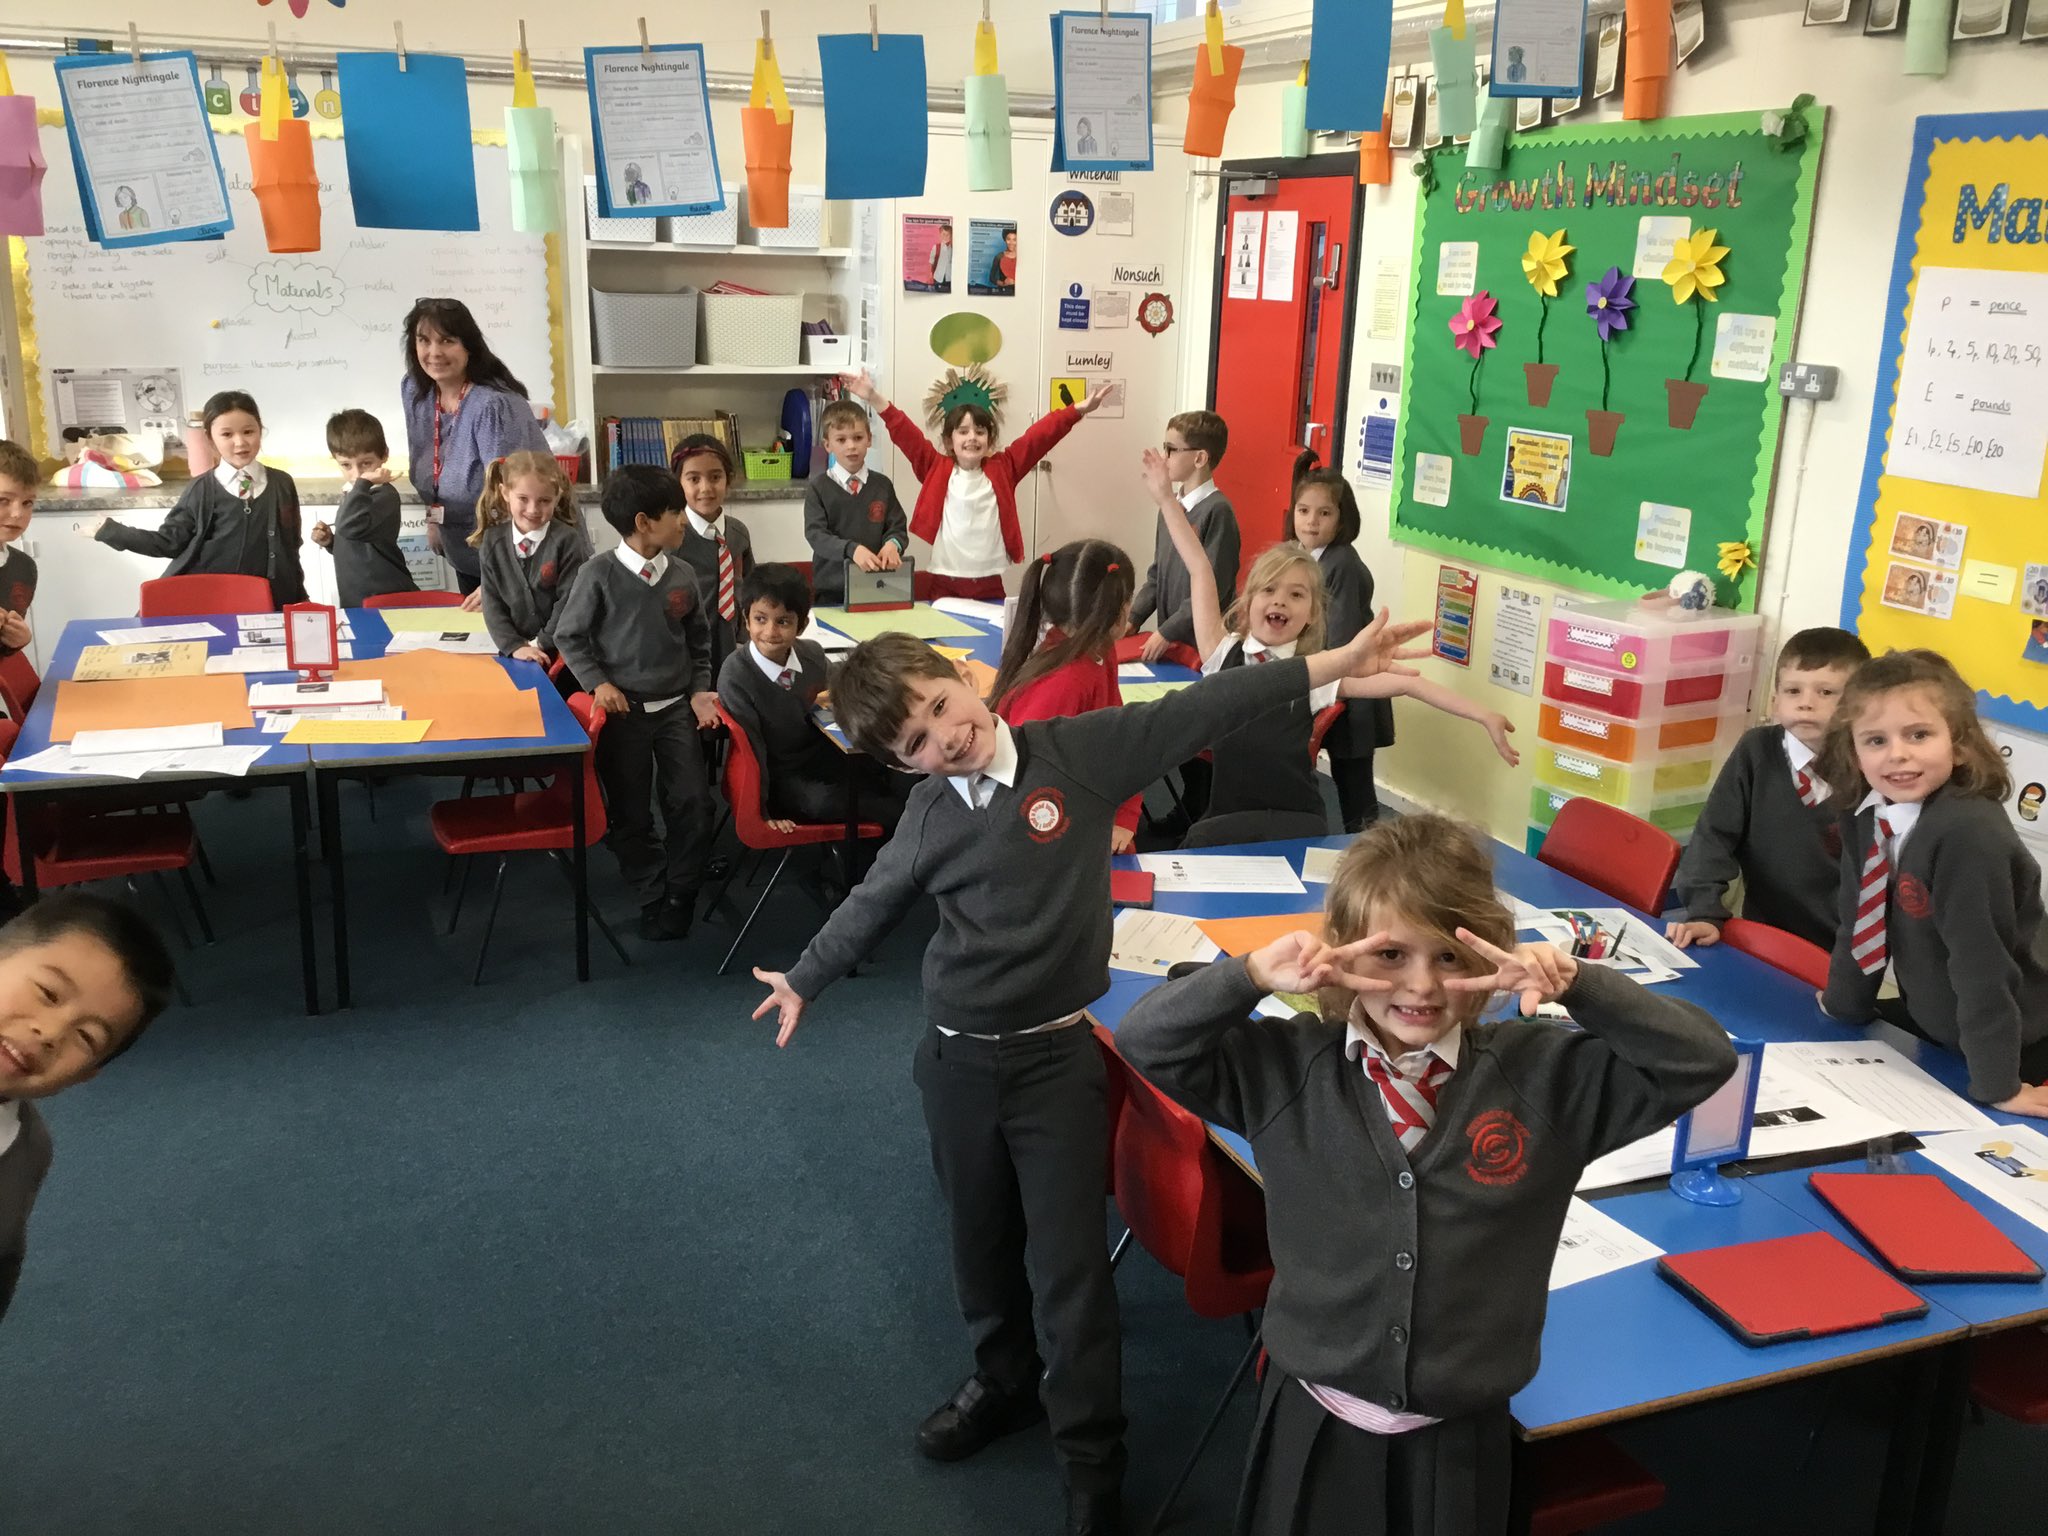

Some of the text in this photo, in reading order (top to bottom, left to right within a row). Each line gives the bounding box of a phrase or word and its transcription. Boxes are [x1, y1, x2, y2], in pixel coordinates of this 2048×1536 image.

[1071, 26, 1098, 36] Florence
[604, 61, 690, 73] Florence Nightingale
[77, 71, 180, 89] Florence Nightingale
[1455, 153, 1744, 214] Growth Mindset
[1952, 183, 2048, 243] Ma
[1113, 267, 1161, 282] Nonsuch
[265, 274, 334, 299] Materials
[1989, 301, 2024, 314] pence
[1068, 354, 1110, 369] Lumley
[1971, 398, 2011, 413] pounds
